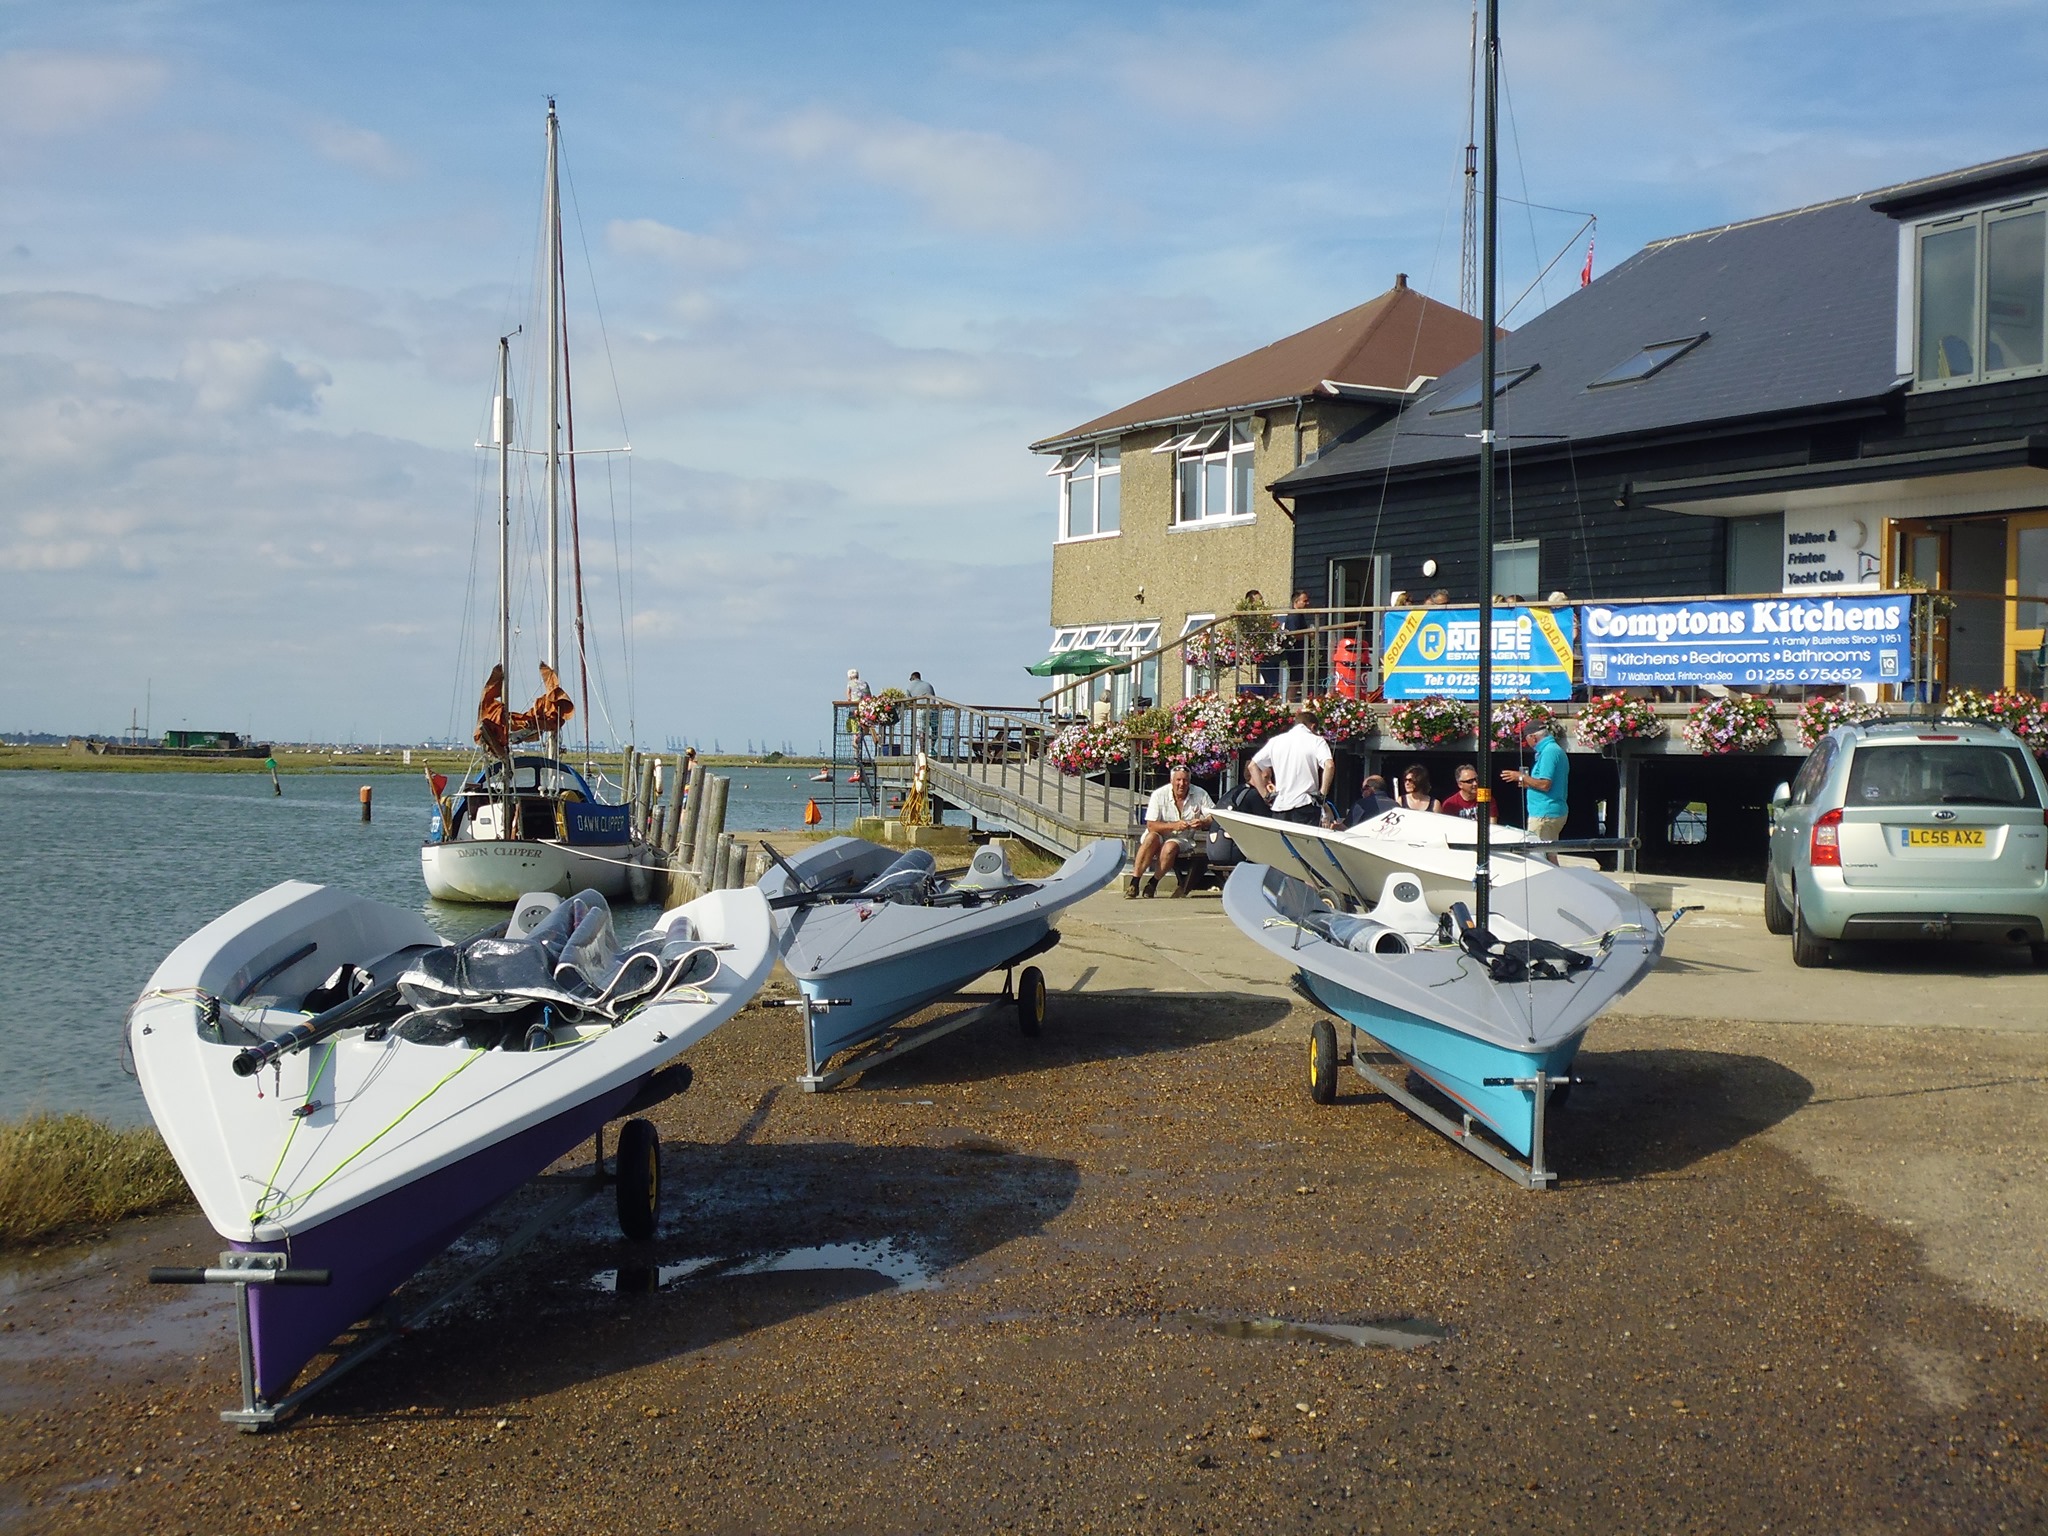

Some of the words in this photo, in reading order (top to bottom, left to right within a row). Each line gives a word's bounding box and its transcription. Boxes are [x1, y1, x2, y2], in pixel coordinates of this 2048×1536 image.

[1788, 532, 1826, 545] Walton
[1828, 530, 1837, 542] &
[1788, 552, 1826, 565] Frinton
[1788, 571, 1818, 585] Yacht
[1820, 570, 1845, 583] Club
[1588, 607, 1746, 642] Comptons
[1751, 600, 1901, 634] Kitchens
[1387, 632, 1408, 664] SOLD
[1406, 615, 1418, 634] IT!
[1540, 615, 1560, 646] SOLD
[1556, 646, 1571, 663] IT!
[1772, 637, 1781, 645] A
[1782, 636, 1811, 647] Family
[1812, 634, 1850, 645] Business
[1851, 634, 1878, 645] Since
[1880, 633, 1902, 643] 1951
[1446, 652, 1481, 660] ESTAT
[1617, 653, 1680, 666] Kitchens
[1689, 651, 1771, 665] Bedrooms
[1782, 649, 1872, 663] Bathrooms
[1424, 674, 1445, 686] Tel:
[1446, 673, 1480, 686] 0125
[1617, 672, 1627, 681] 17
[1628, 672, 1654, 681] Walton
[1678, 671, 1733, 681] Frinton-on-Sea
[1746, 669, 1795, 681] 01255
[1798, 668, 1863, 681] 675652
[577, 814, 600, 832] DAWN
[600, 815, 625, 832] CLIPPER
[1380, 811, 1405, 825] RS
[1910, 830, 1950, 844] LC56
[1954, 830, 1983, 844] AXZ
[456, 847, 489, 858] DAWN
[493, 846, 543, 858] CLIPPER
